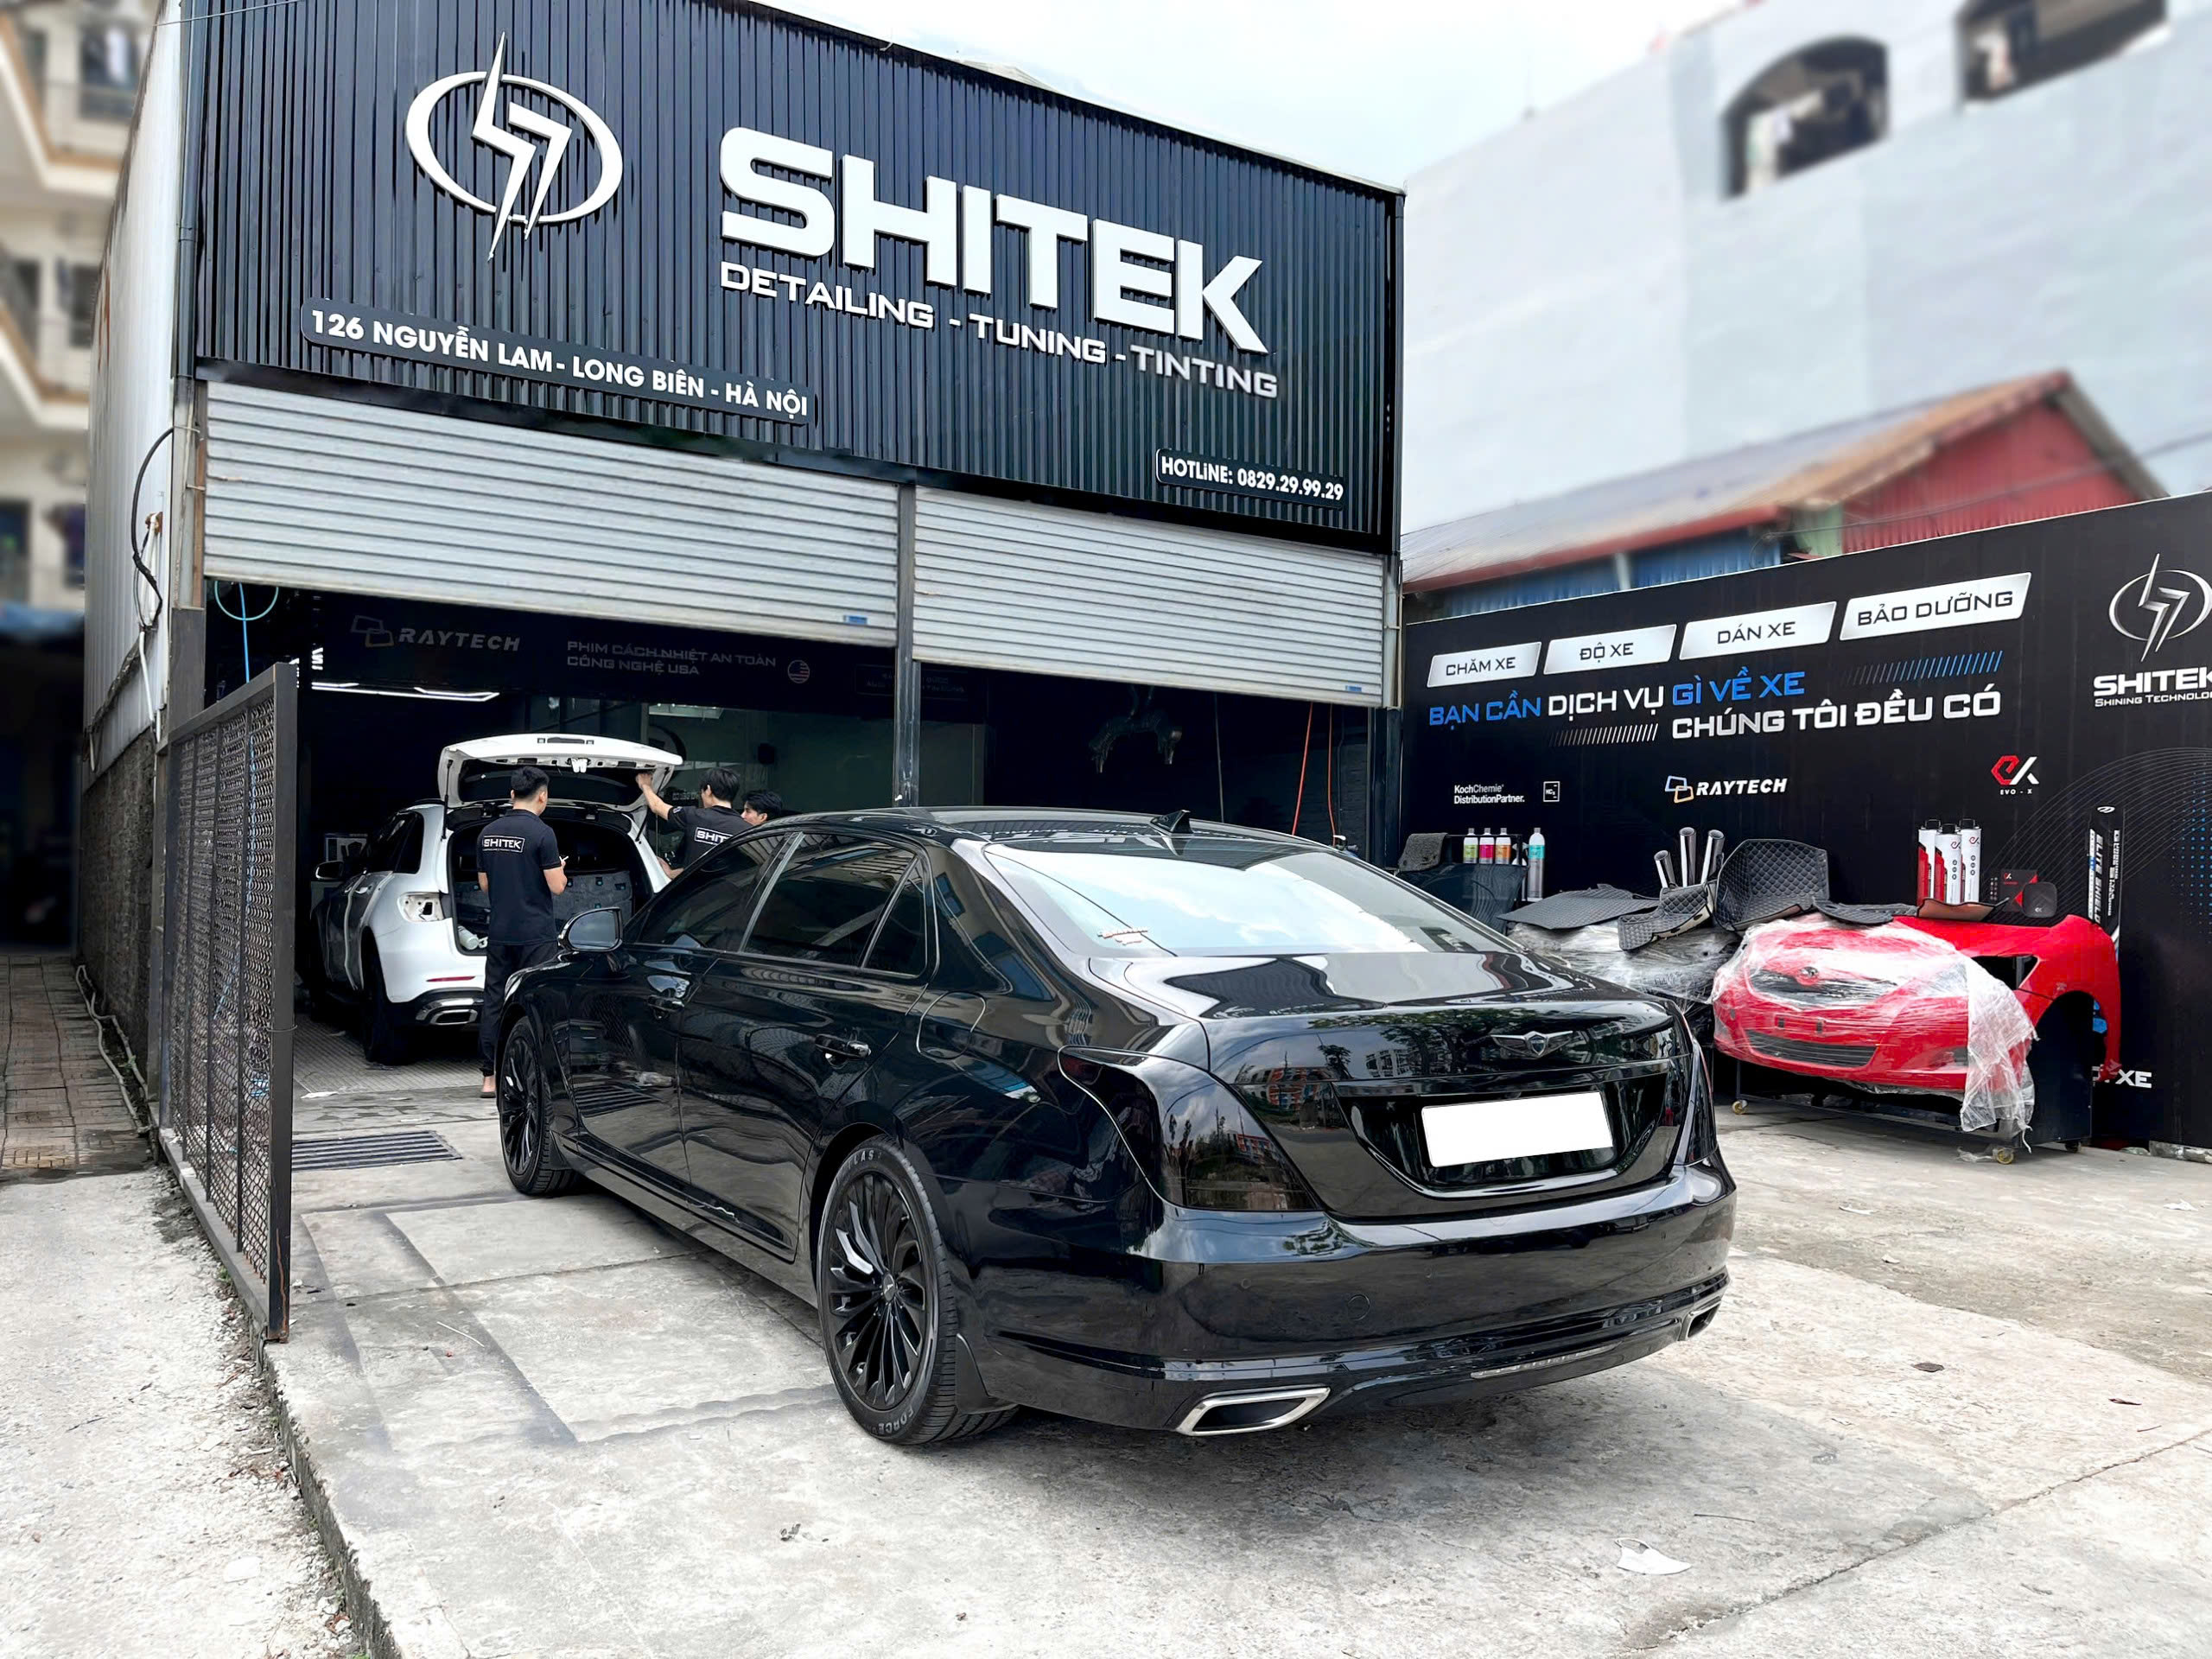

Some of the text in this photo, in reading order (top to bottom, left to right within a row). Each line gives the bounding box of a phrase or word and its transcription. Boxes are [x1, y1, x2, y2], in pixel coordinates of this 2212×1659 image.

[720, 126, 1269, 354] SHITEK
[720, 261, 934, 329] DETAILING
[969, 313, 1107, 364] TUNING
[1129, 344, 1278, 398] TINTING
[312, 309, 365, 340] 126
[372, 321, 488, 362] NGUYỄN
[499, 342, 552, 372] LAM
[572, 355, 645, 387] LONG
[652, 368, 704, 398] BIÊN
[725, 380, 760, 408] HÀ
[766, 389, 808, 419] NỘI
[1237, 467, 1344, 501] 0829.29.99.29
[1857, 588, 2014, 627] BẢO DƯỠNG
[398, 627, 521, 652] RAYTECH
[1717, 621, 1796, 645] DÁN XE
[567, 641, 776, 667] PHIM CÁCH NHIỆT AN TOÀN
[1580, 641, 1634, 664] ĐỘ XE
[567, 655, 699, 676] CÔNG NGHỆ USA
[1446, 657, 1516, 677] CHĂM XE
[1429, 665, 1806, 730] BẠN CẦN DỊCH VỤ GÌ VỀ XE
[1671, 683, 2002, 739] CHÚNG TÔI ĐỀU CÓ
[1453, 793, 1526, 804] DistributionPartner.
[1696, 778, 1788, 796] RAYTECH
[484, 838, 522, 849] SHITEK
[2114, 1069, 2152, 1088] XE
